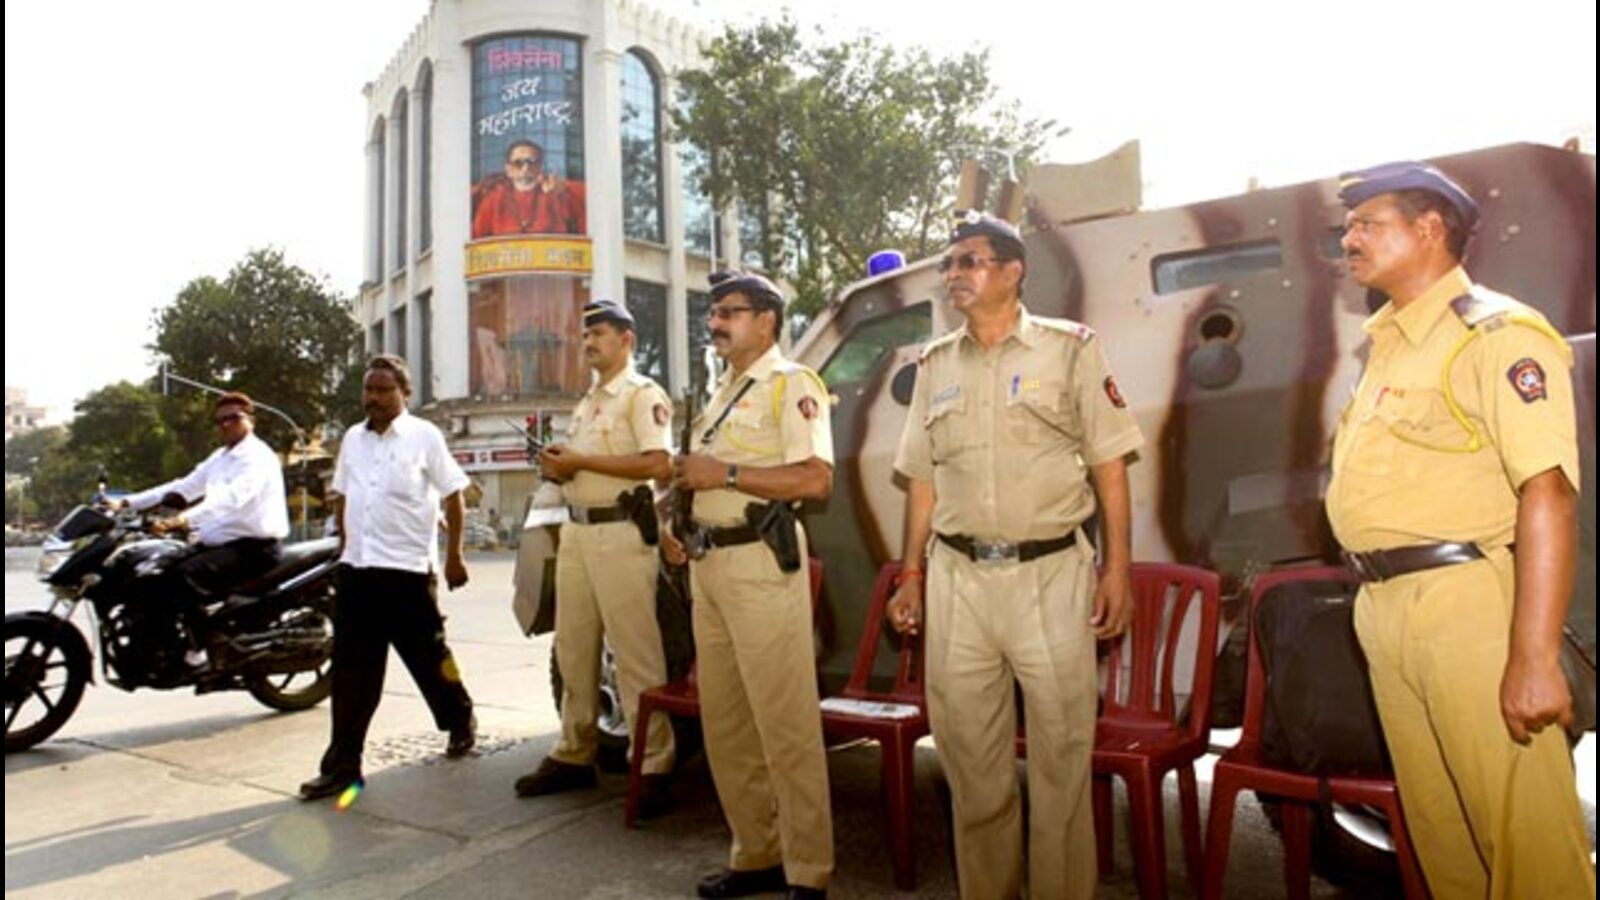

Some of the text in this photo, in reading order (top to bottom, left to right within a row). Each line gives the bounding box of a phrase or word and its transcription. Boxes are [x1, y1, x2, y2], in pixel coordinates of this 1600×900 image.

[487, 46, 562, 73] शिवसेना
[501, 76, 540, 102] जय
[479, 101, 572, 135] महाराष्ट्र
